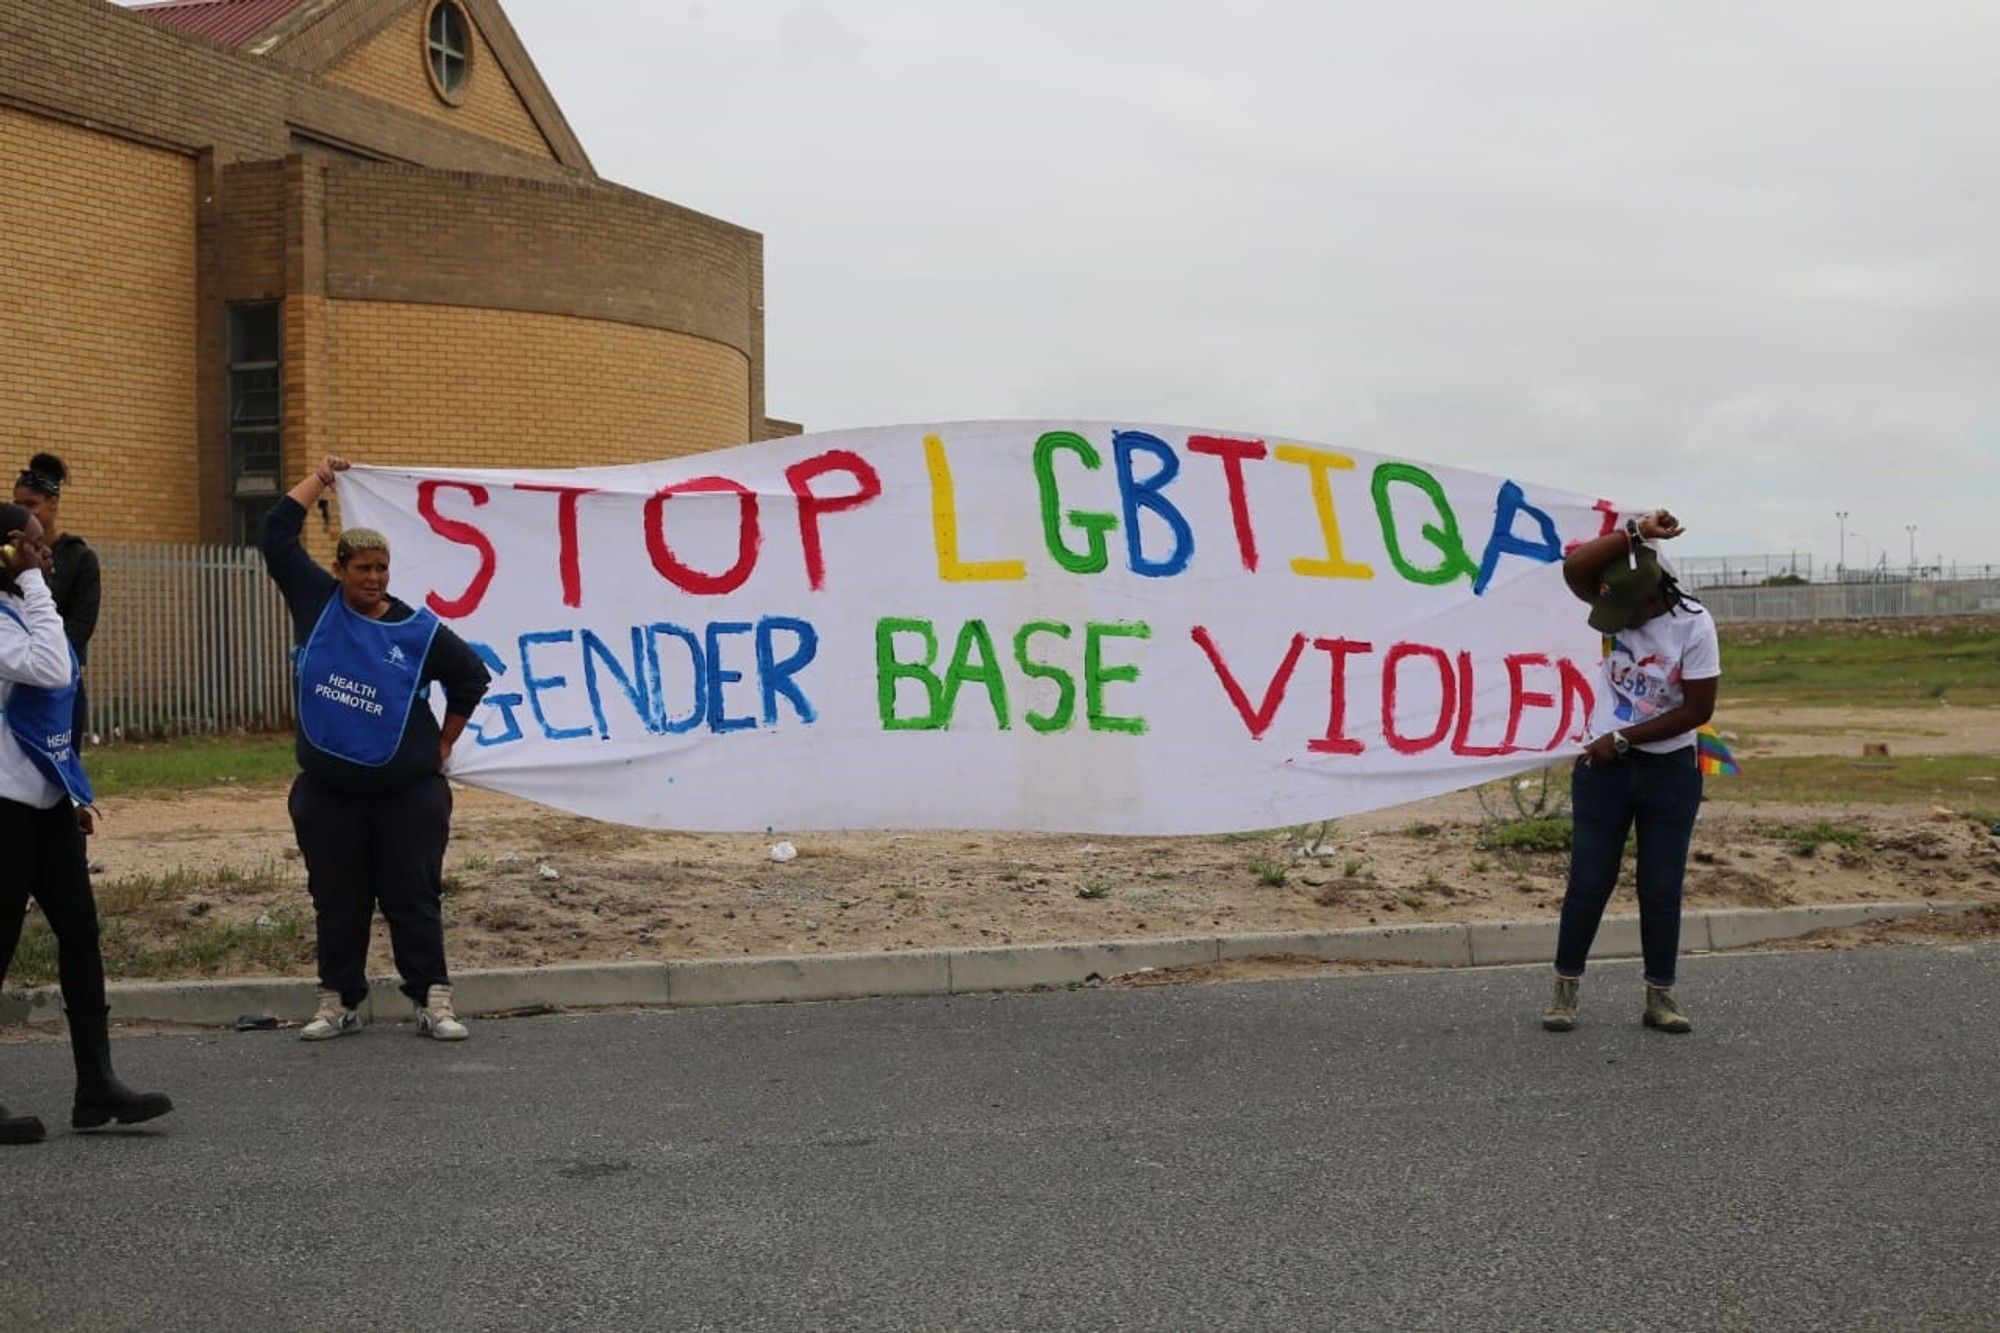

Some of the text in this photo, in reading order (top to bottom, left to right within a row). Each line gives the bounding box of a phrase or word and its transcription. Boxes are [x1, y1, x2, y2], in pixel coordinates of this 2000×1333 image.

[418, 449, 881, 620] STOP
[315, 684, 383, 716] PROMOTER
[328, 673, 377, 699] HEALTH
[876, 616, 1152, 736] BASE
